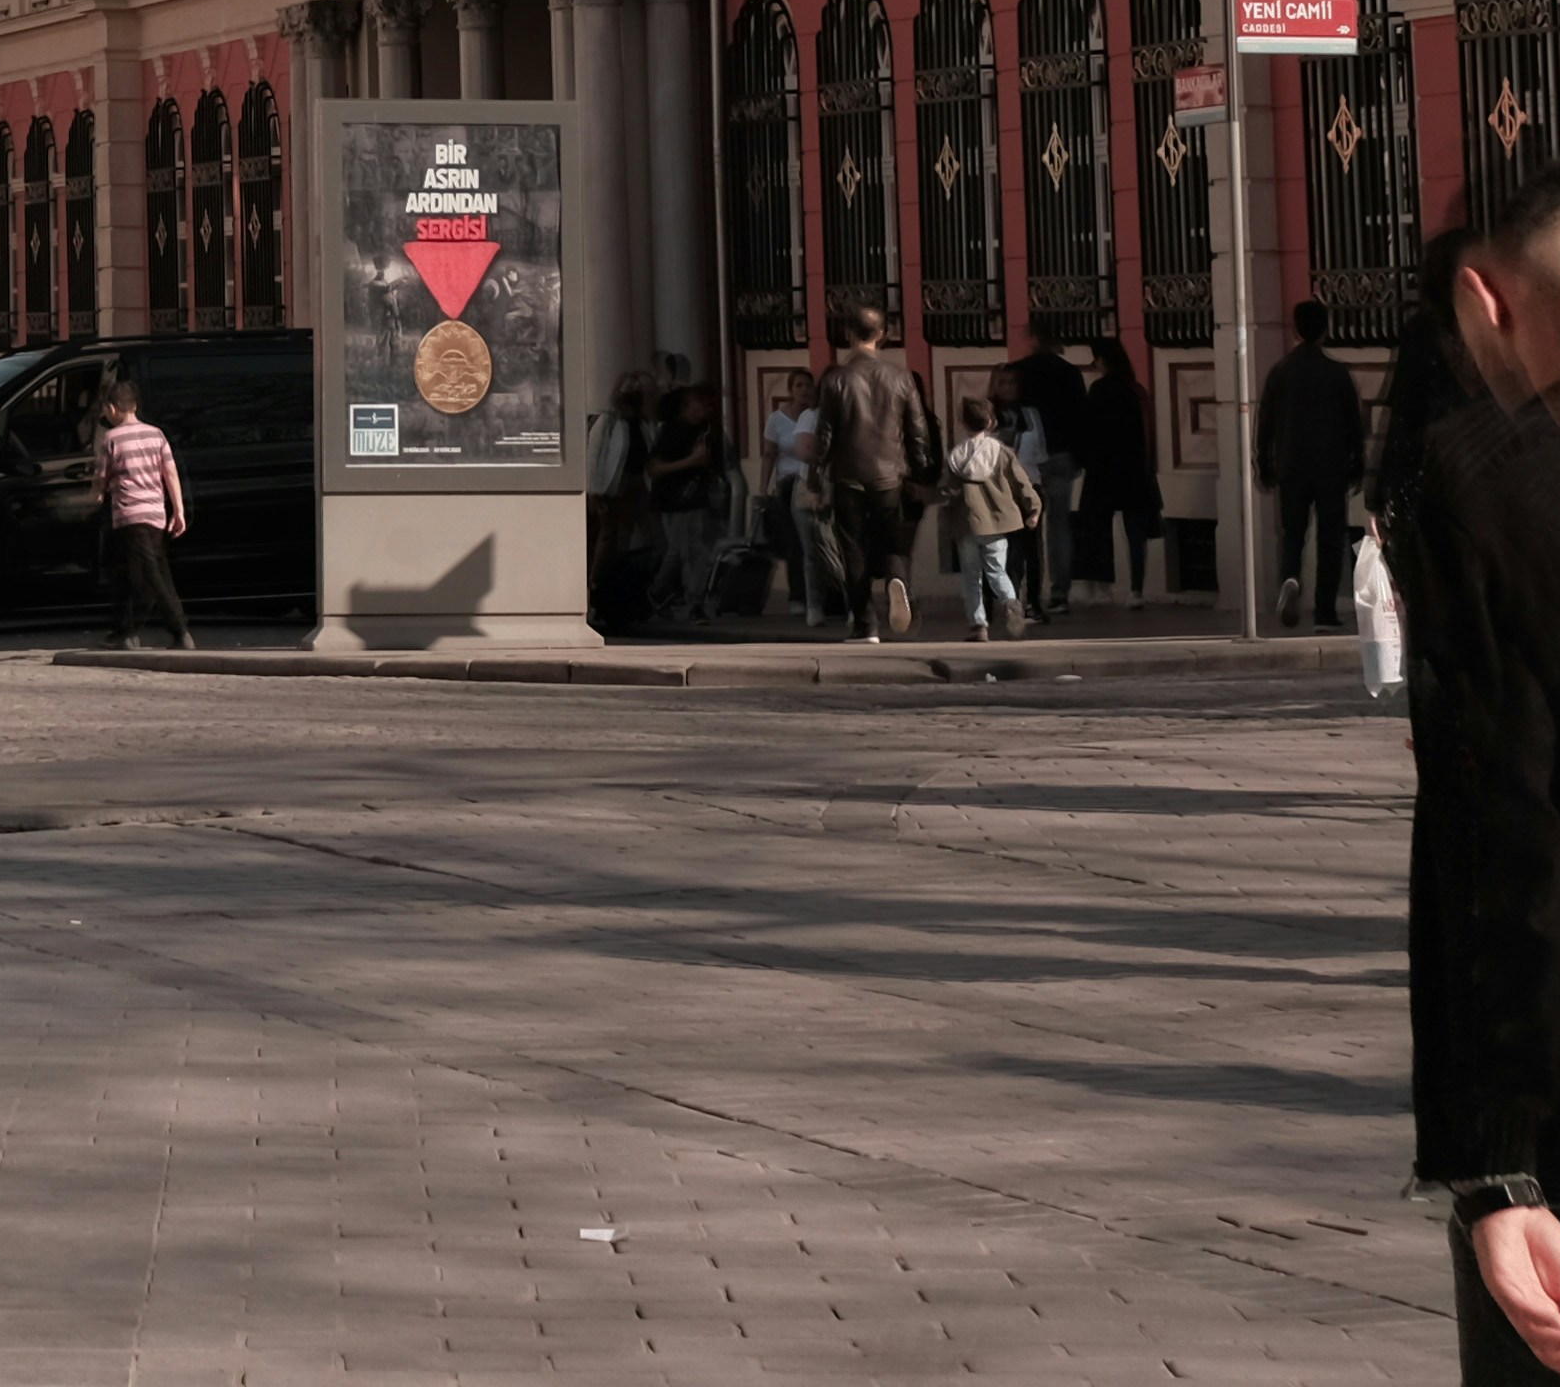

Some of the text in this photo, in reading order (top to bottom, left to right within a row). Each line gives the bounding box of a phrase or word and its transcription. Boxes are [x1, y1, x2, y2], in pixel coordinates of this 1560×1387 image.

[1242, 0, 1333, 20] YENİ CAMİİ
[1242, 23, 1286, 33] CADDESİ
[435, 139, 467, 165] BİR
[423, 168, 479, 190] ASRIN
[405, 192, 498, 214] ARDINDAN
[416, 215, 488, 240] SERGİSİ
